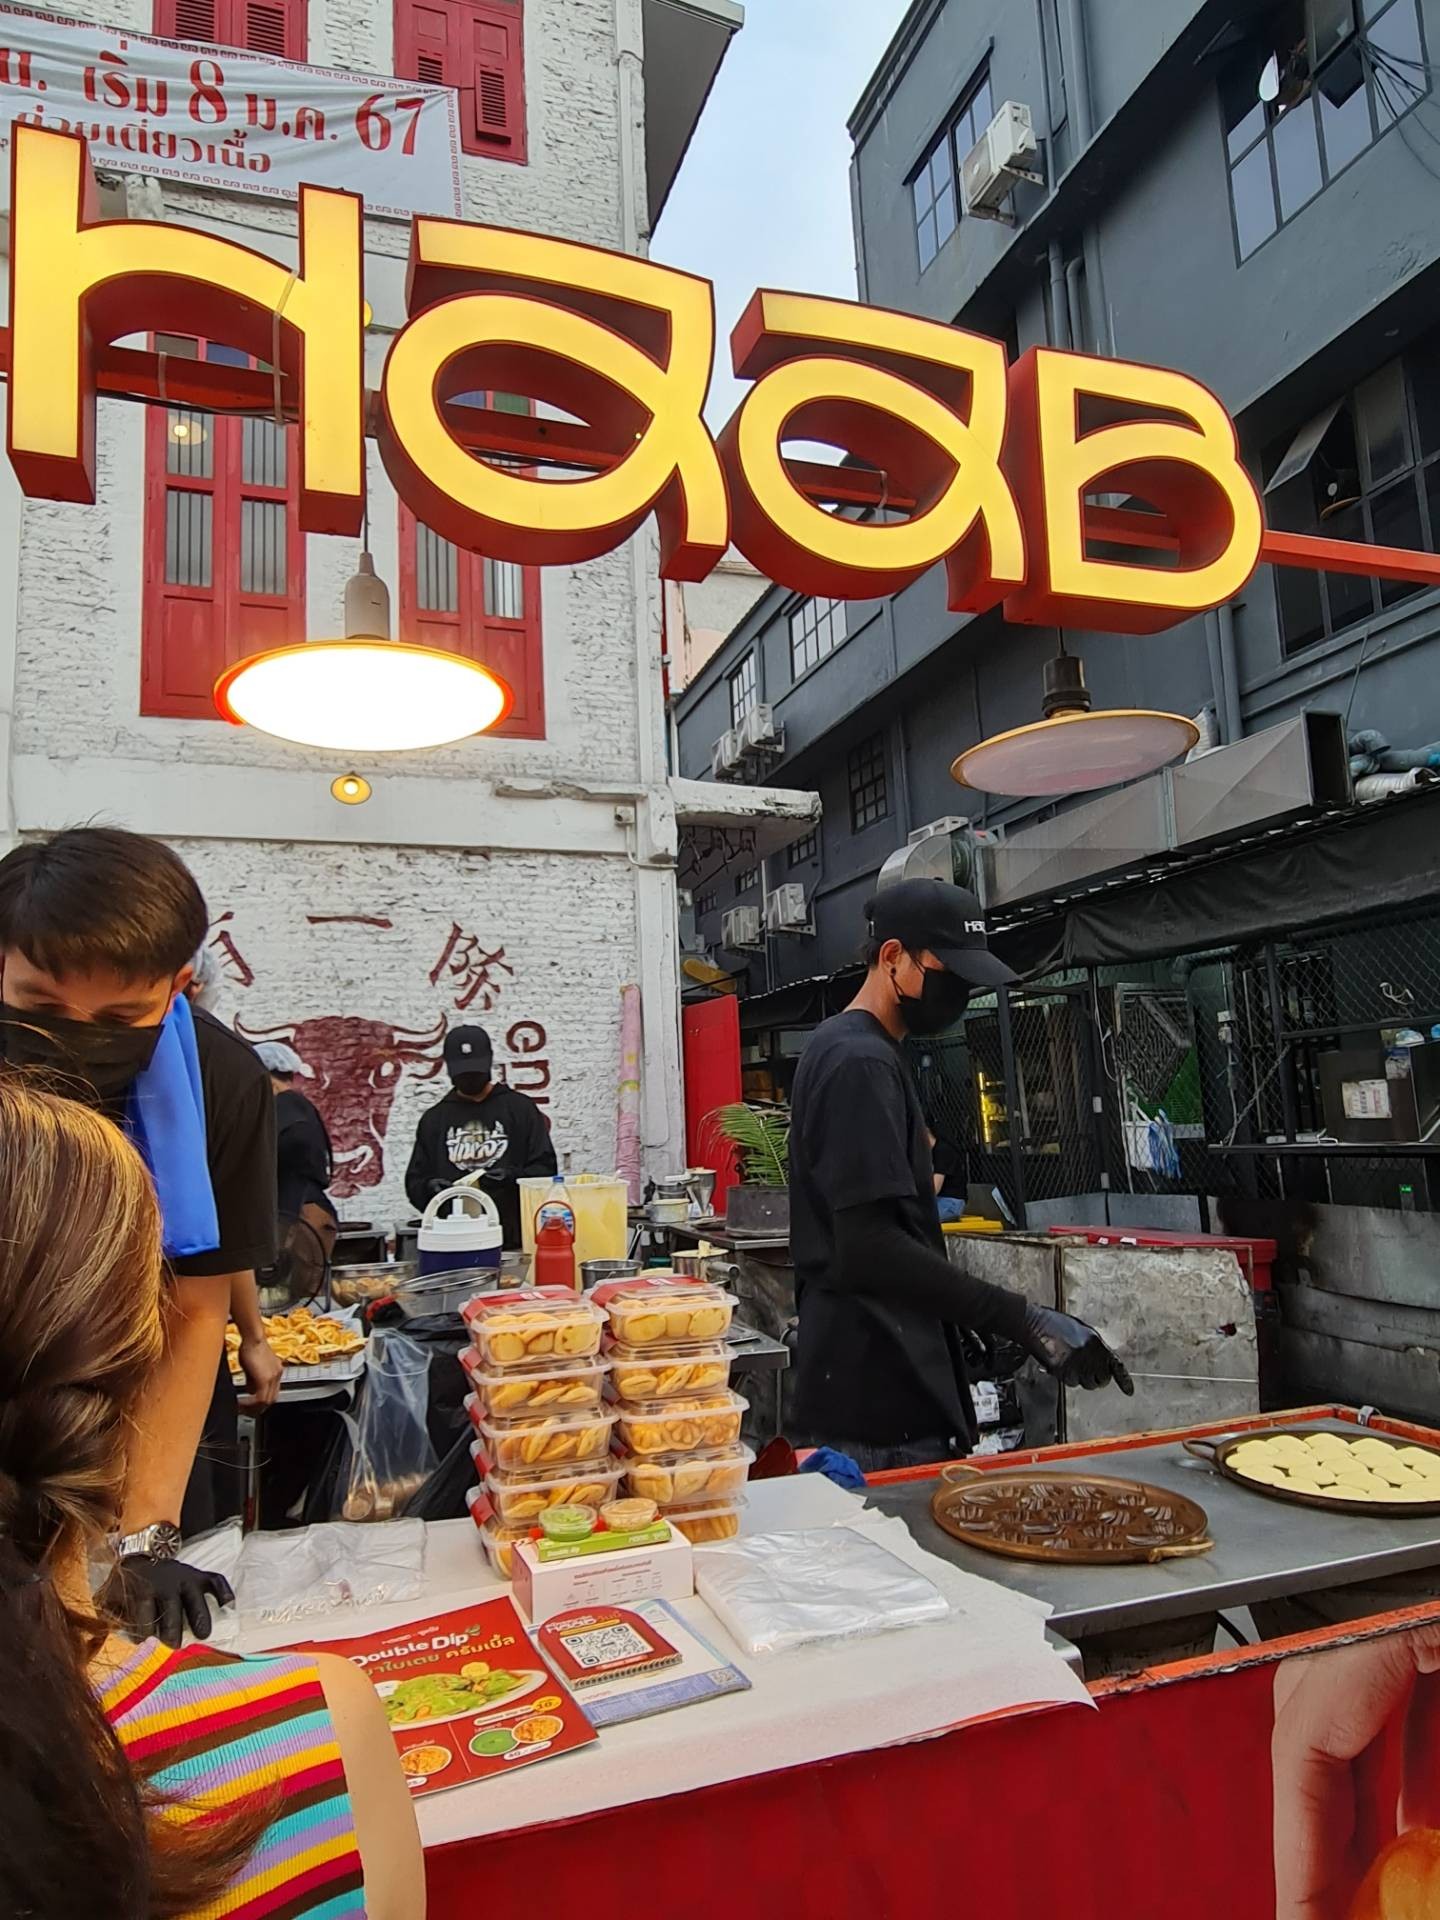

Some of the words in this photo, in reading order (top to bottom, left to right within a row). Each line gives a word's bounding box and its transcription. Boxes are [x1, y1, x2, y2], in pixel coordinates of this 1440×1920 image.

[83, 40, 168, 117] เริ่ม
[187, 59, 228, 124] 8
[244, 92, 338, 142] ม.ค.
[354, 93, 426, 155] 67
[347, 1638, 431, 1668] Double
[432, 1632, 470, 1651] Dip
